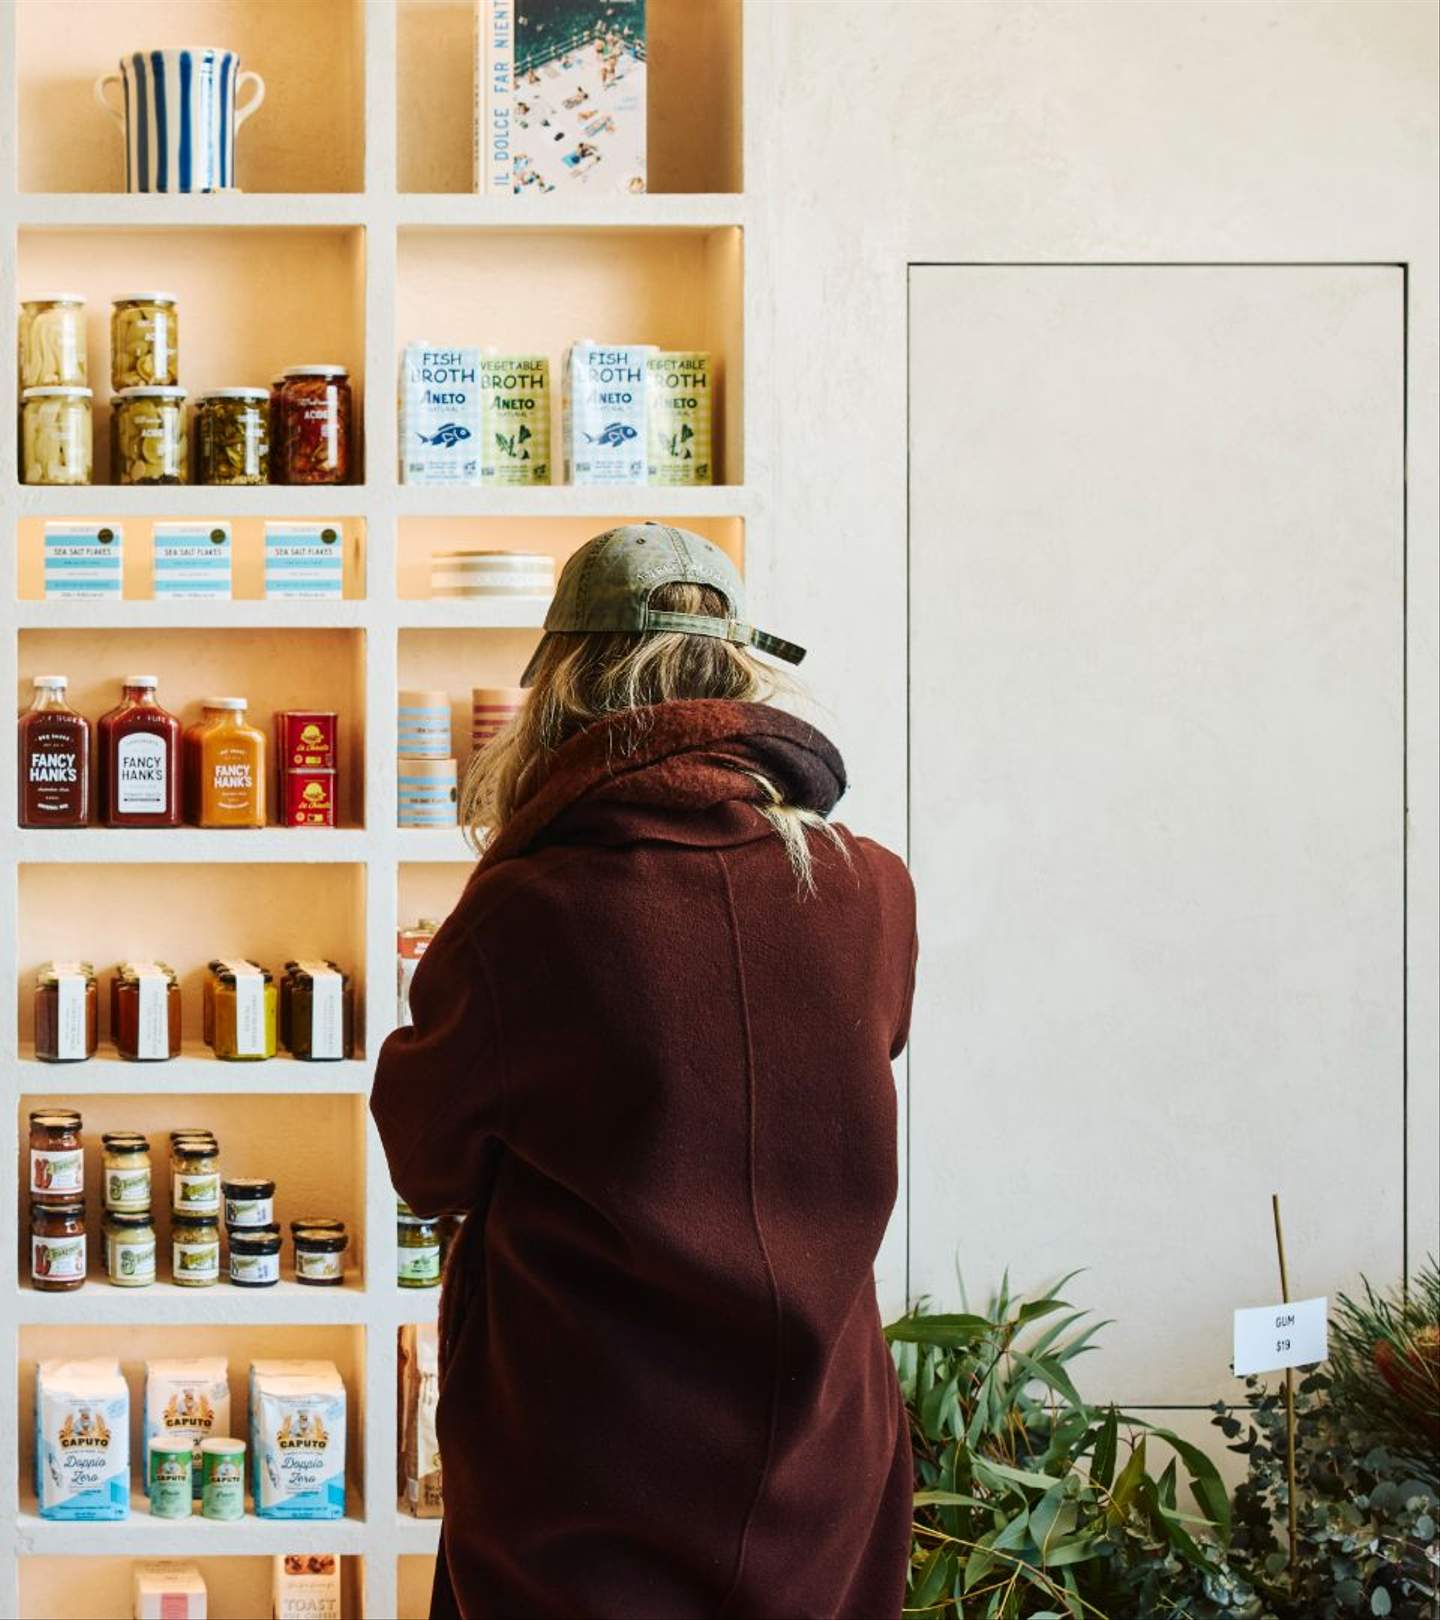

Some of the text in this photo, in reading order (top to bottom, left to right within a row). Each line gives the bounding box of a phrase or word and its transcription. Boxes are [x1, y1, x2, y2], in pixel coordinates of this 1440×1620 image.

[494, 61, 509, 93] FAR
[494, 108, 509, 161] DOLCE
[422, 353, 462, 366] FISH
[588, 352, 628, 366] FISH
[481, 361, 543, 371] VEGETABLE
[481, 375, 544, 389] BROTH
[580, 368, 641, 383] ROTH
[586, 390, 632, 404] NETO
[54, 548, 111, 556] SEA SALT FLAKES
[164, 548, 222, 556] SEA SALT FLAKES
[275, 548, 333, 556] SEA SALT FLAKES
[32, 753, 76, 767] FANCY
[123, 757, 161, 768] FANCY
[215, 764, 251, 776] FANCY
[1275, 1315, 1295, 1328] GUM
[1276, 1339, 1291, 1352] $19
[166, 1418, 212, 1428] CAPUTO
[62, 1438, 109, 1447] CAPUTO
[280, 1440, 327, 1449] CAPUTO
[64, 1455, 106, 1470] Doppio
[281, 1456, 324, 1470] Doppio
[71, 1471, 98, 1486] Zero
[288, 1472, 316, 1486] Zero
[285, 1598, 336, 1611] TOAST
